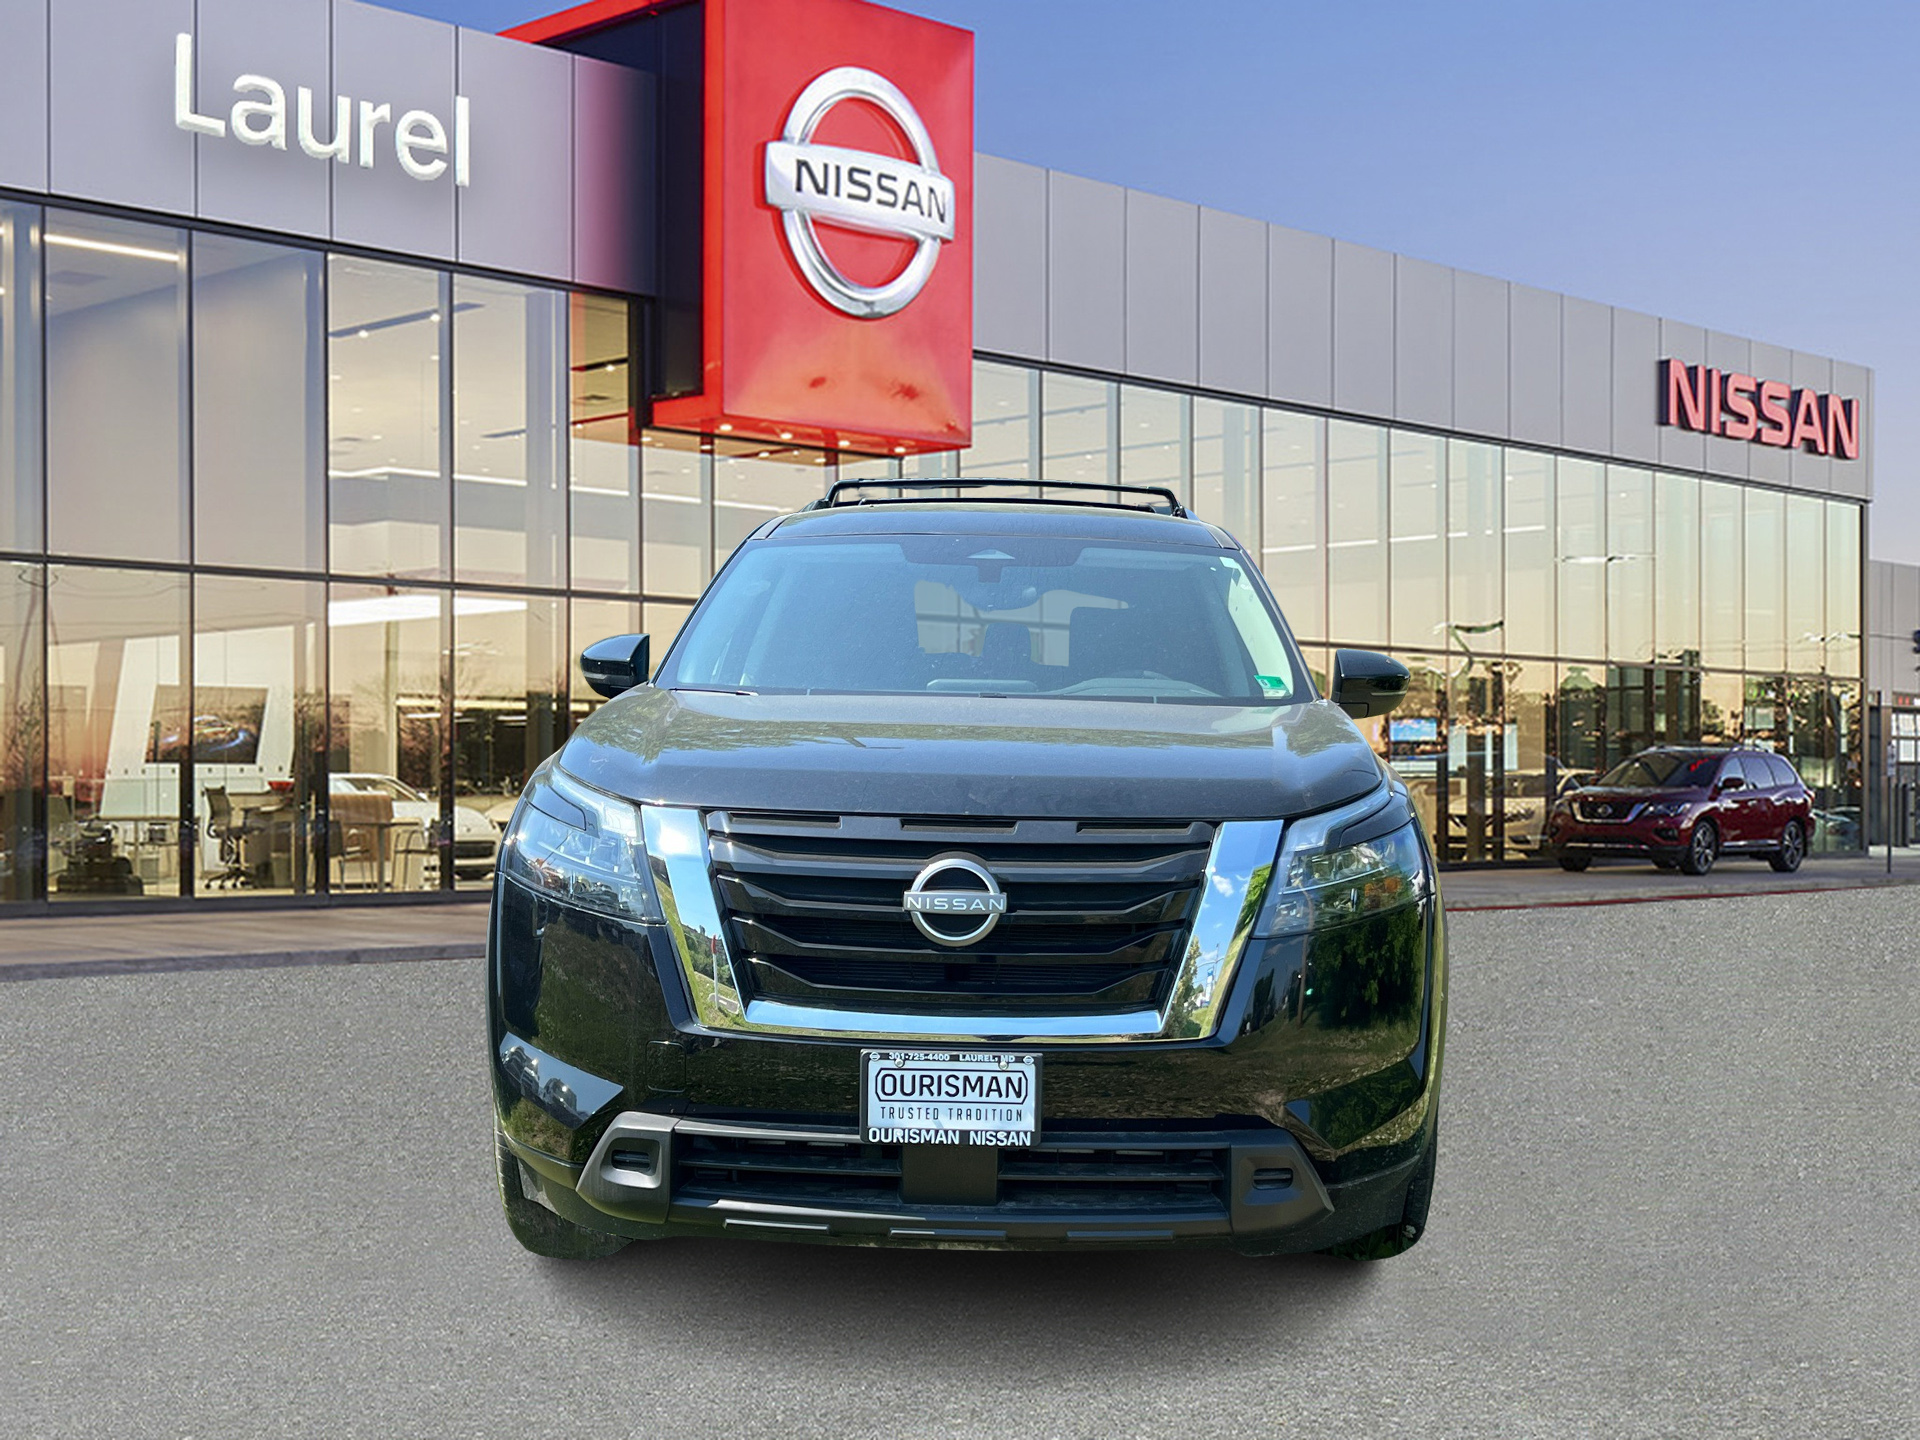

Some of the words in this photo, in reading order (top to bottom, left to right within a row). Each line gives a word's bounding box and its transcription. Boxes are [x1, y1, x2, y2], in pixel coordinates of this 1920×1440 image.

[175, 33, 470, 188] Laurel
[795, 158, 946, 223] NISSAN
[1660, 358, 1859, 460] NISSAN
[907, 896, 1004, 911] NISSAN
[1000, 1055, 1016, 1063] MD
[880, 1073, 1022, 1099] OURISMAN
[880, 1106, 939, 1120] TRUSTED
[949, 1108, 1022, 1122] TRADITION
[868, 1127, 960, 1145] OURISMAN
[969, 1130, 1031, 1146] NISSAN
